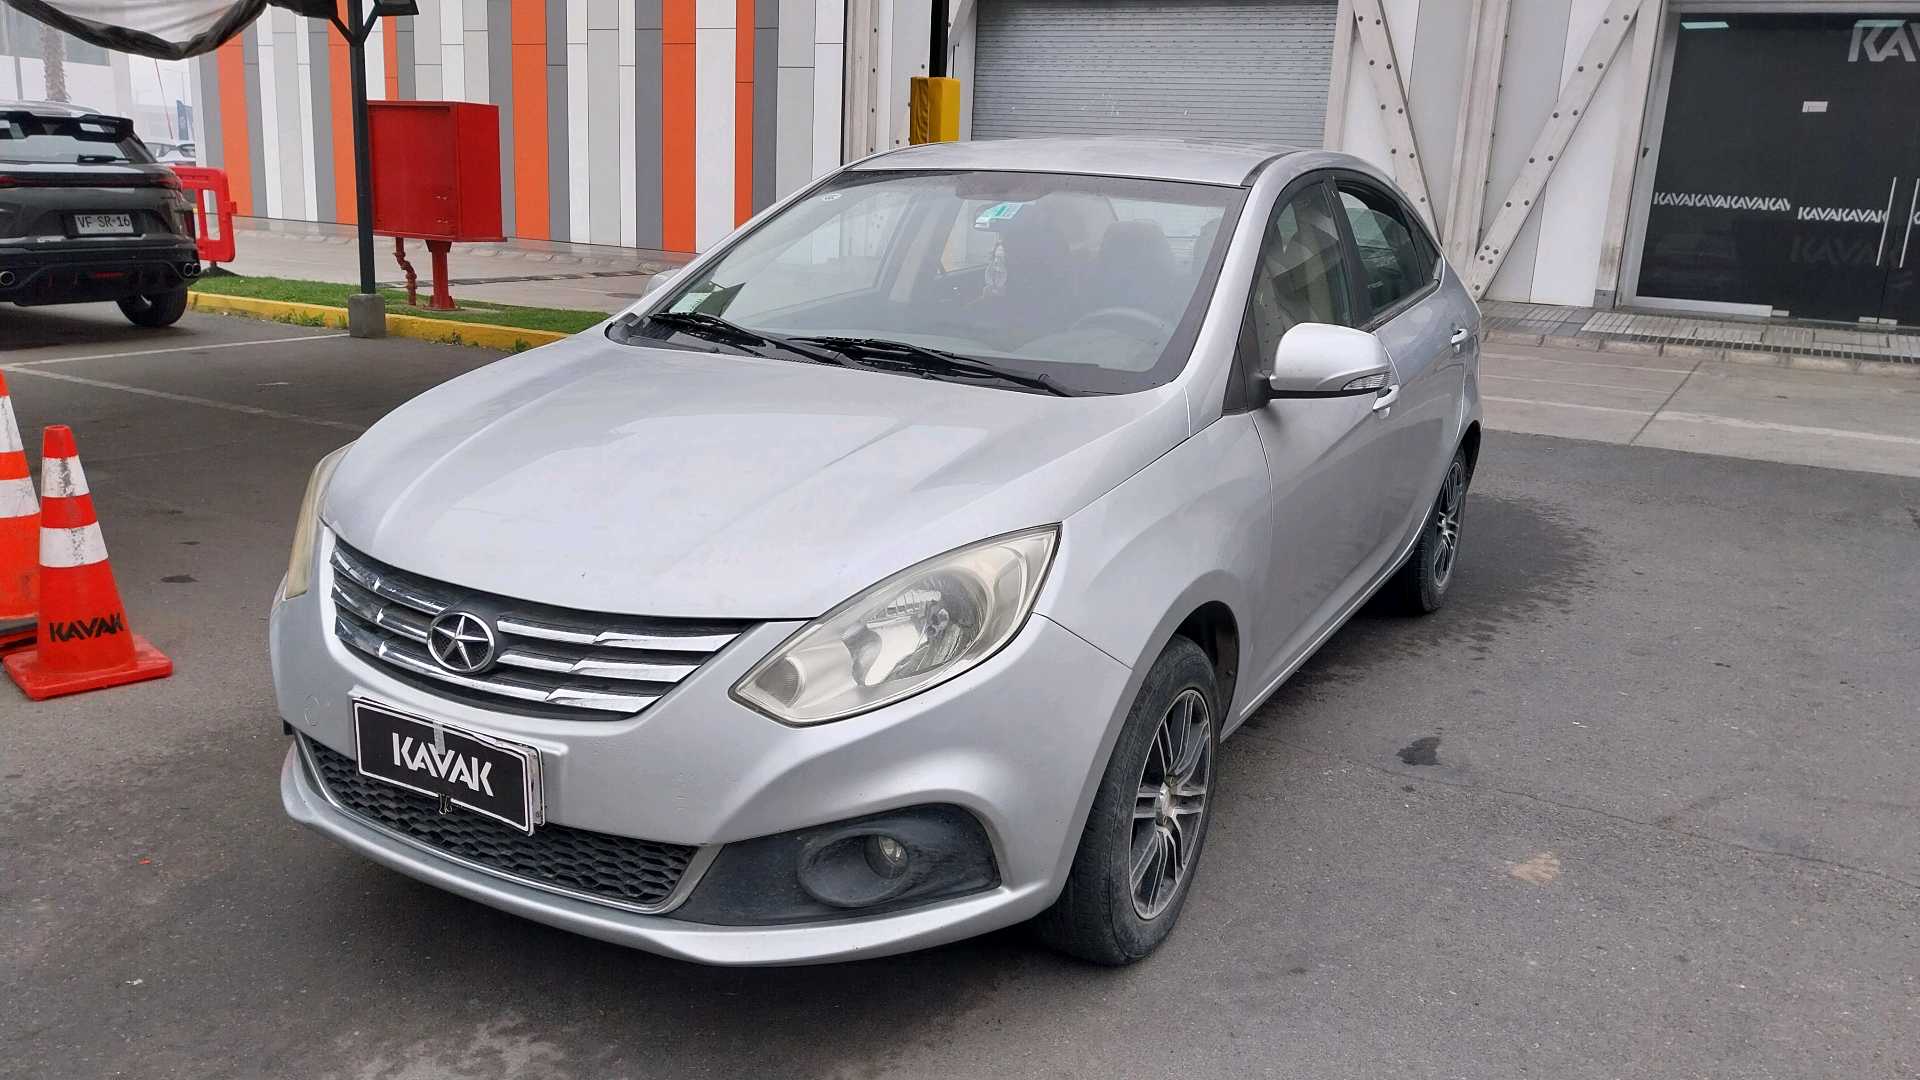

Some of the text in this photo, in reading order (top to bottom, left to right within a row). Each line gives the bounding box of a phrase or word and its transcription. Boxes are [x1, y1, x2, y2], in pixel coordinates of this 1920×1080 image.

[77, 215, 92, 228] VF
[49, 613, 123, 642] KAVAK
[392, 732, 494, 797] KAVAK
